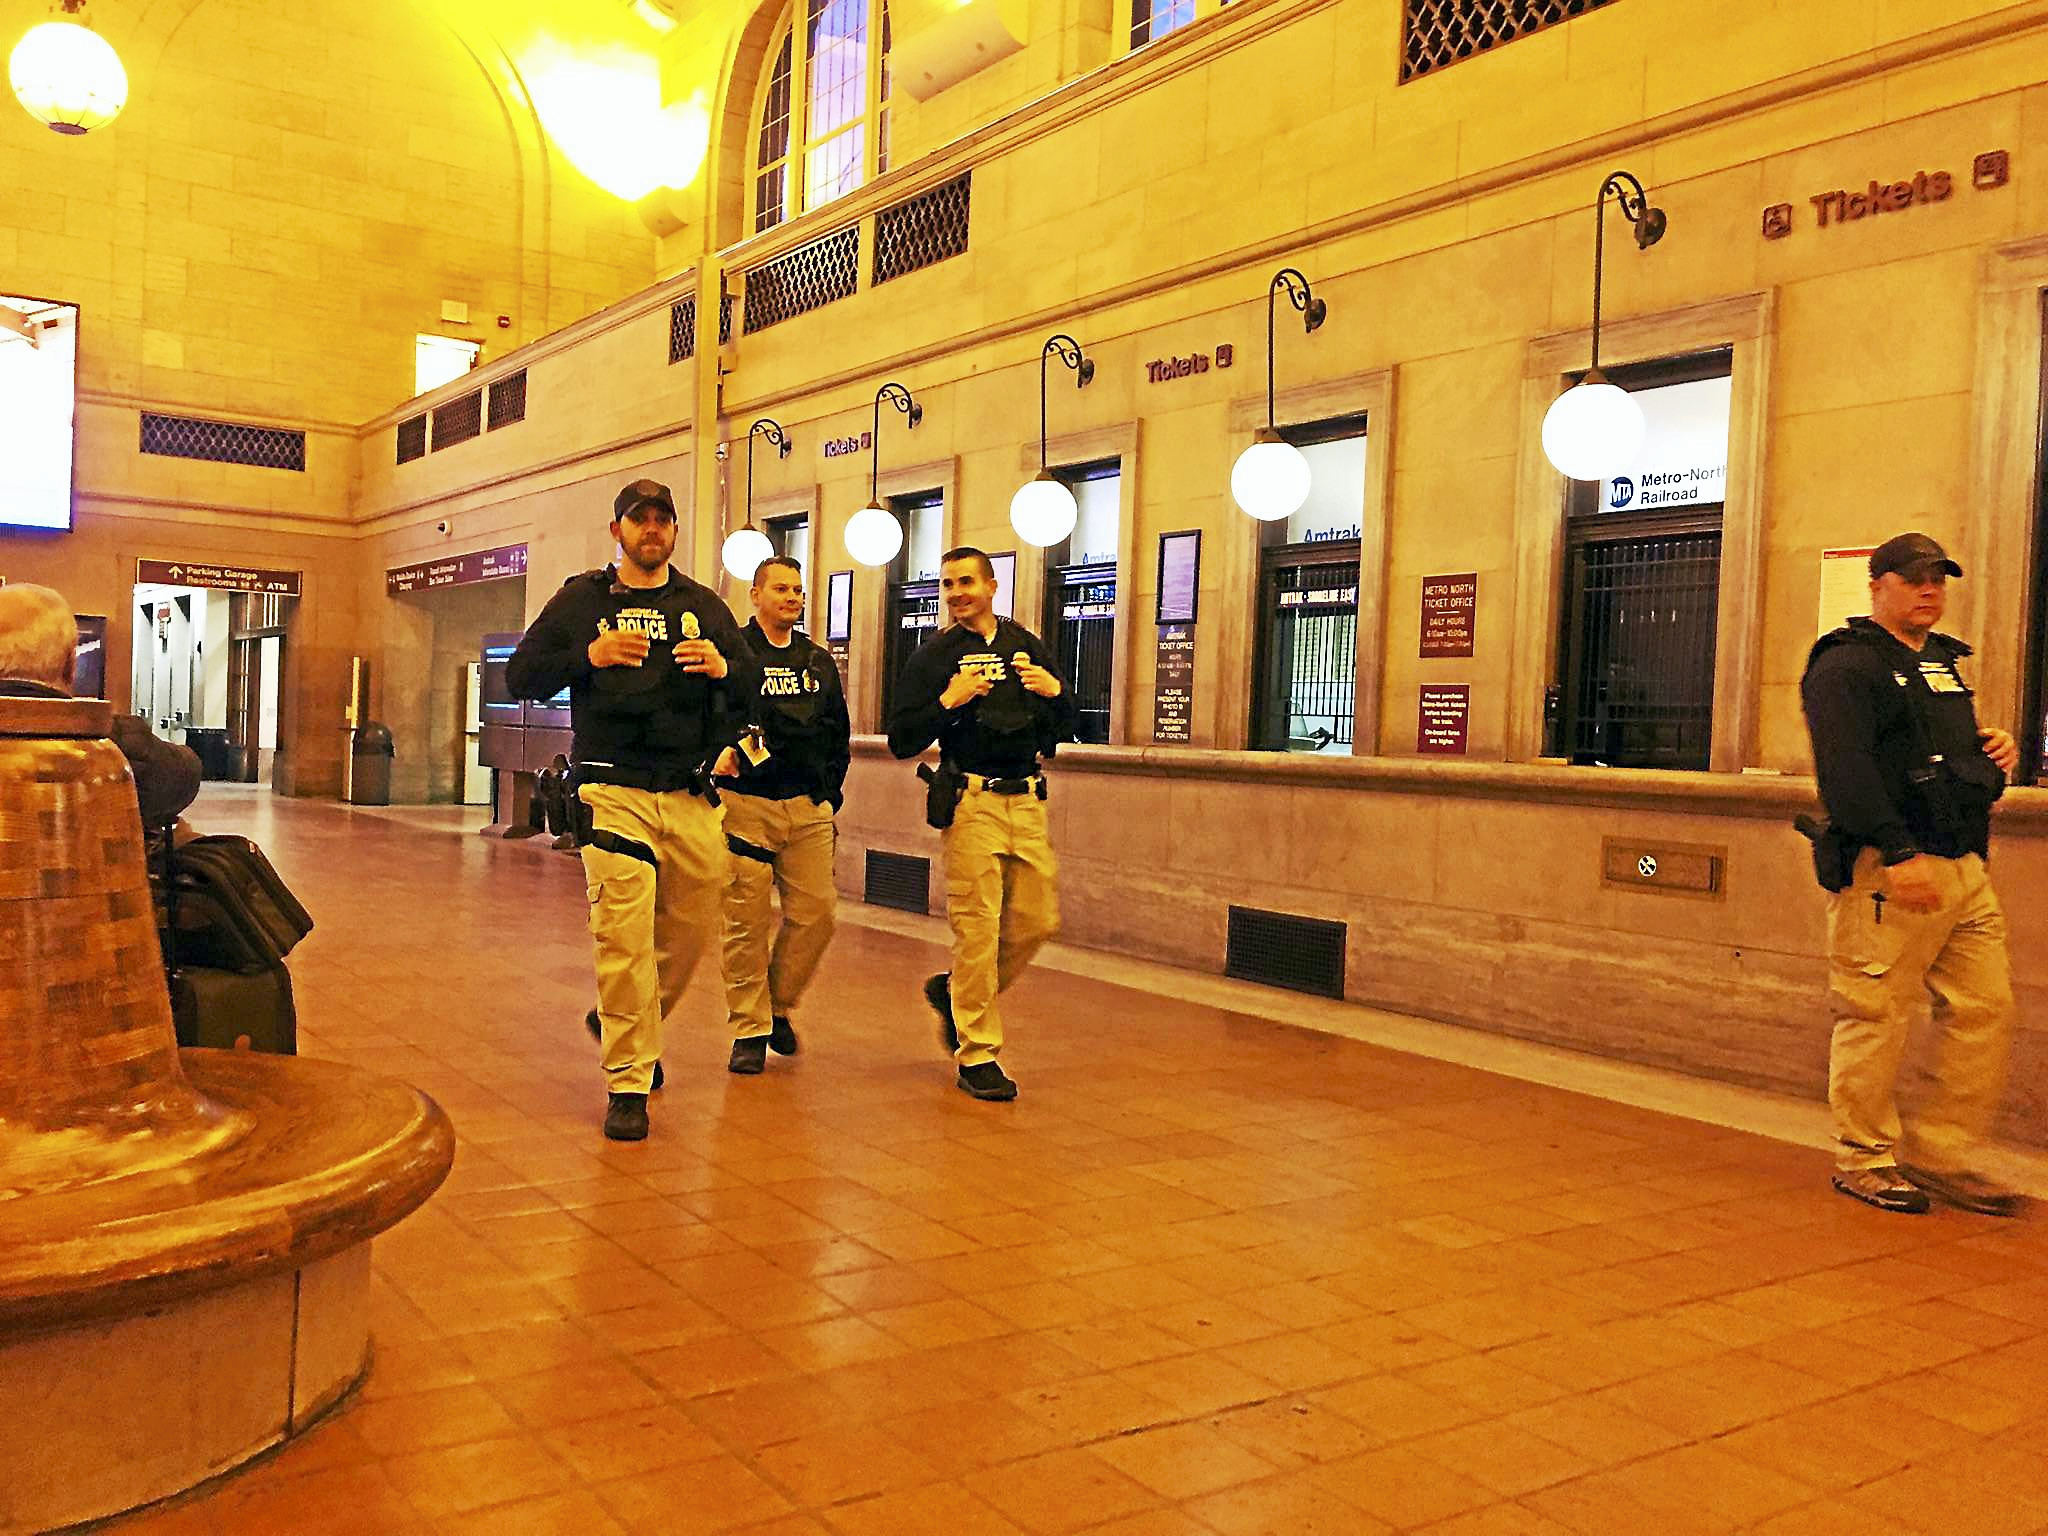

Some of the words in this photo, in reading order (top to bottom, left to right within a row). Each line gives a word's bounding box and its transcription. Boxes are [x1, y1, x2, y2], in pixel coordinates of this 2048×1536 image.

[1809, 170, 1952, 227] Tickets
[1145, 353, 1209, 384] Tickets
[1641, 486, 1698, 504] Railroad
[187, 566, 221, 578] Parking
[224, 569, 258, 580] Garage
[187, 576, 237, 587] Restrooms
[267, 582, 288, 591] ATM
[1425, 585, 1448, 596] METRO
[1450, 584, 1474, 594] NORTH
[1424, 598, 1448, 608] TICKET
[1450, 597, 1474, 607] OFFICE
